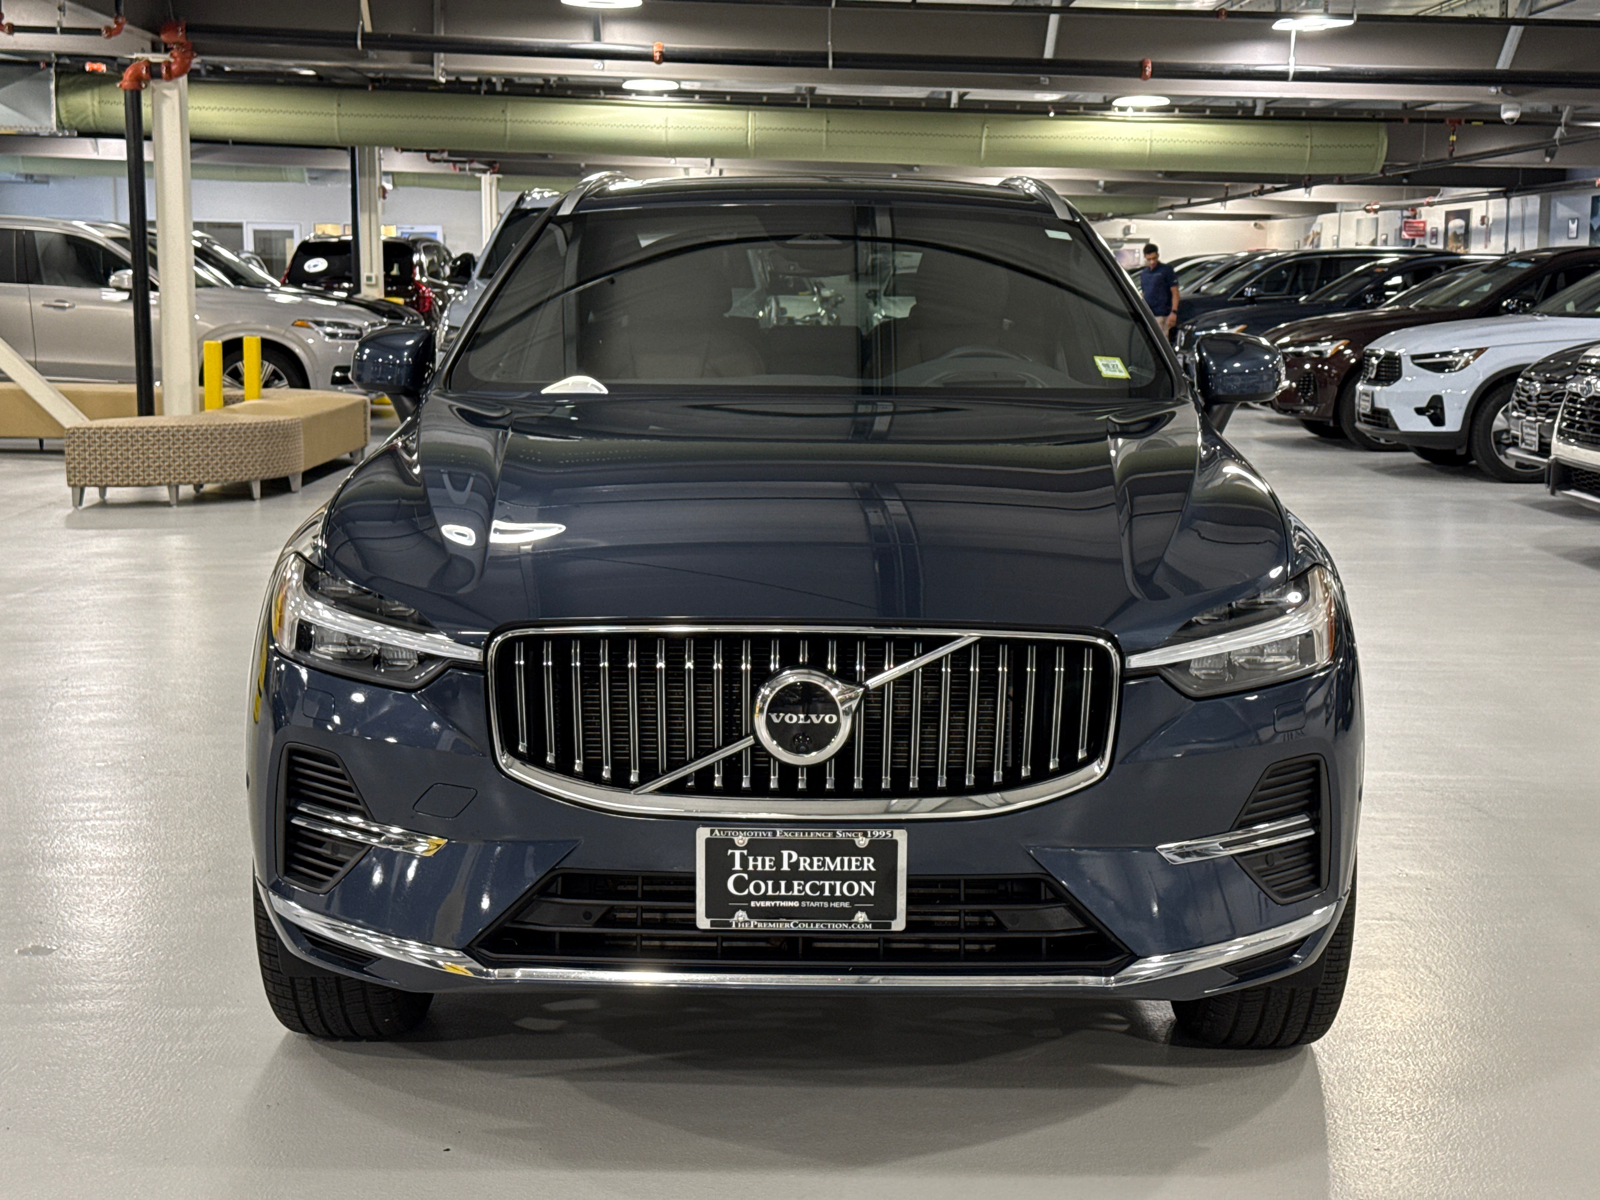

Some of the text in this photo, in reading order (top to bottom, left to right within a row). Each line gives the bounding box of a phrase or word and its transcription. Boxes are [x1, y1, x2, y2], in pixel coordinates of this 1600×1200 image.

[768, 713, 838, 724] VOLVO
[711, 829, 892, 838] AUTOMOTIVE EXCELLENCE SINCE 1995
[727, 849, 876, 871] THE PREMIER
[727, 873, 876, 896] COLLECTION
